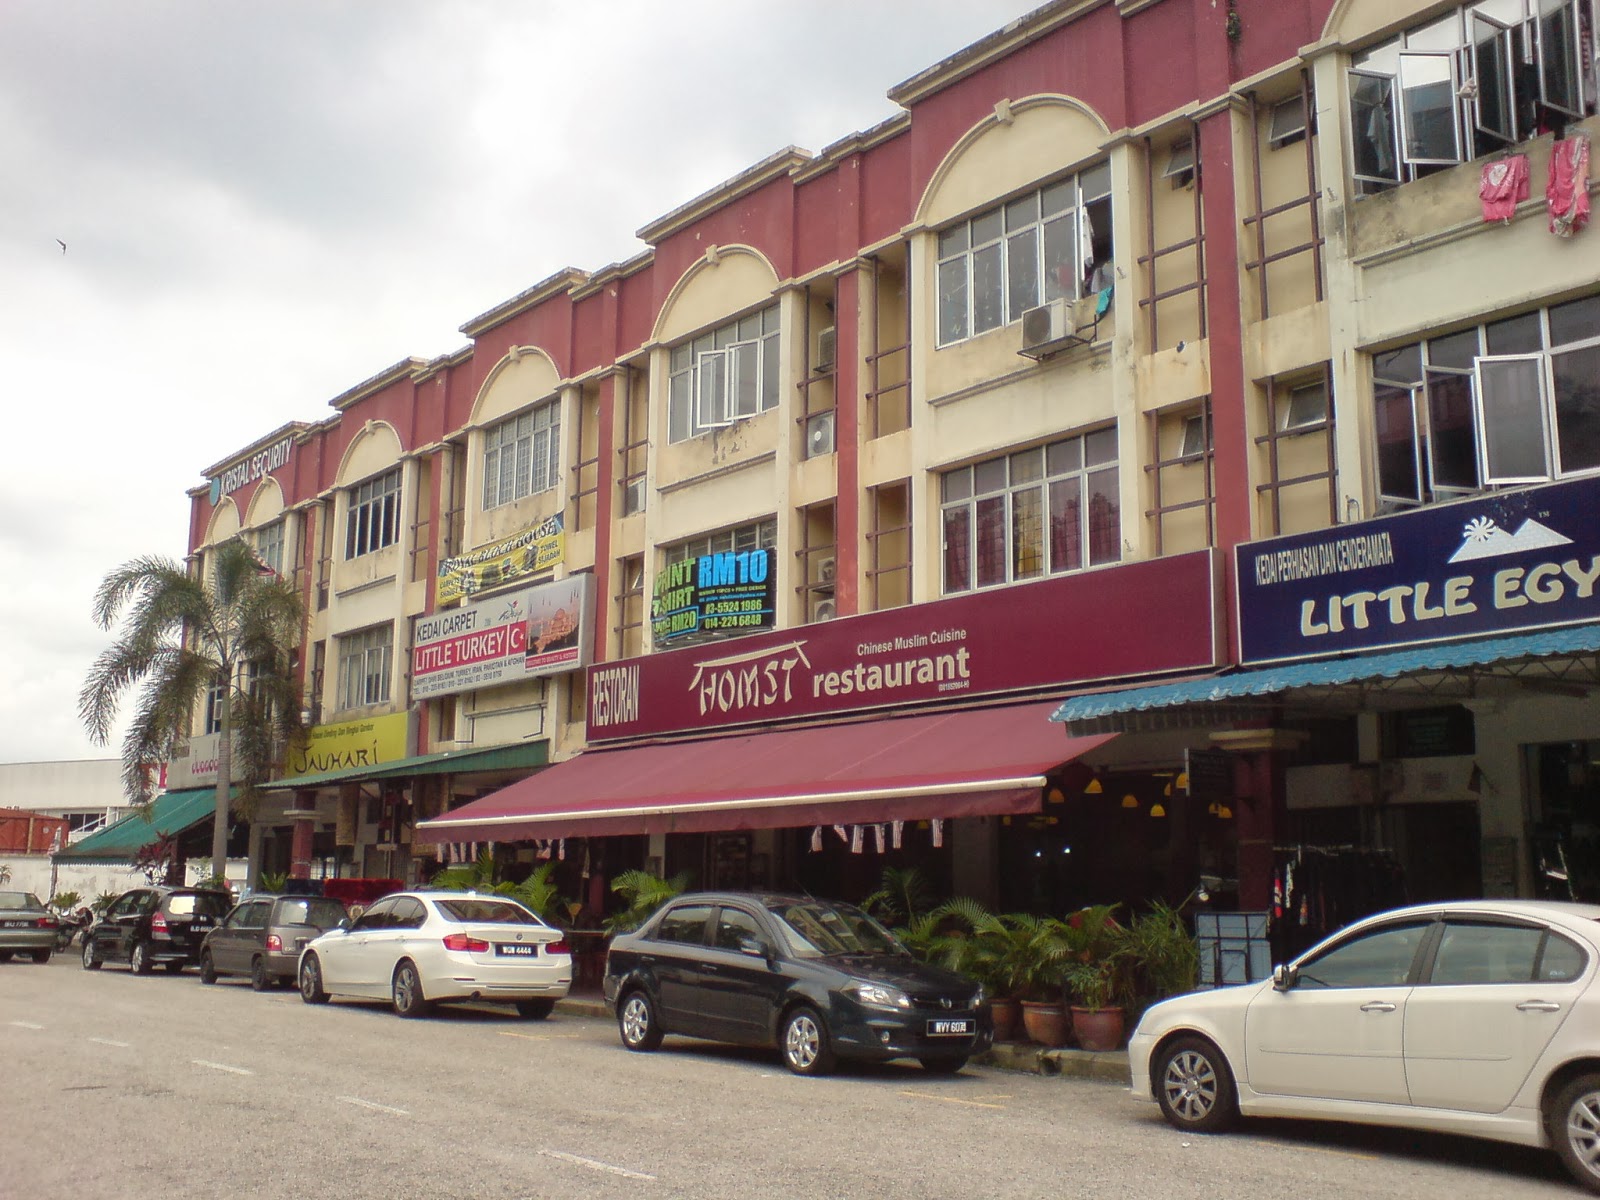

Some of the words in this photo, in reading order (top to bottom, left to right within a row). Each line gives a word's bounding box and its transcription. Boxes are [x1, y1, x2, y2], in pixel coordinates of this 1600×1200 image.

[251, 436, 293, 481] SECURITY
[698, 549, 768, 589] RM10
[1255, 551, 1278, 586] KEDAI
[1278, 545, 1320, 582] PERHIASAN
[1320, 541, 1337, 576] DAN
[1336, 531, 1394, 573] CENDERAMATA
[740, 598, 762, 612] 1986
[1301, 575, 1478, 637] LITTLE
[1494, 555, 1600, 610] EGY
[416, 619, 441, 643] KEDAI
[442, 610, 478, 636] CARPET
[857, 640, 893, 656] Chinese
[894, 633, 928, 651] Muslim
[930, 627, 967, 644] Cuisine
[415, 643, 452, 671] LITTLE
[455, 629, 505, 663] TURKEY
[592, 664, 640, 728] RESTORAN
[697, 654, 803, 716] HOMST
[813, 646, 971, 698] restaurant
